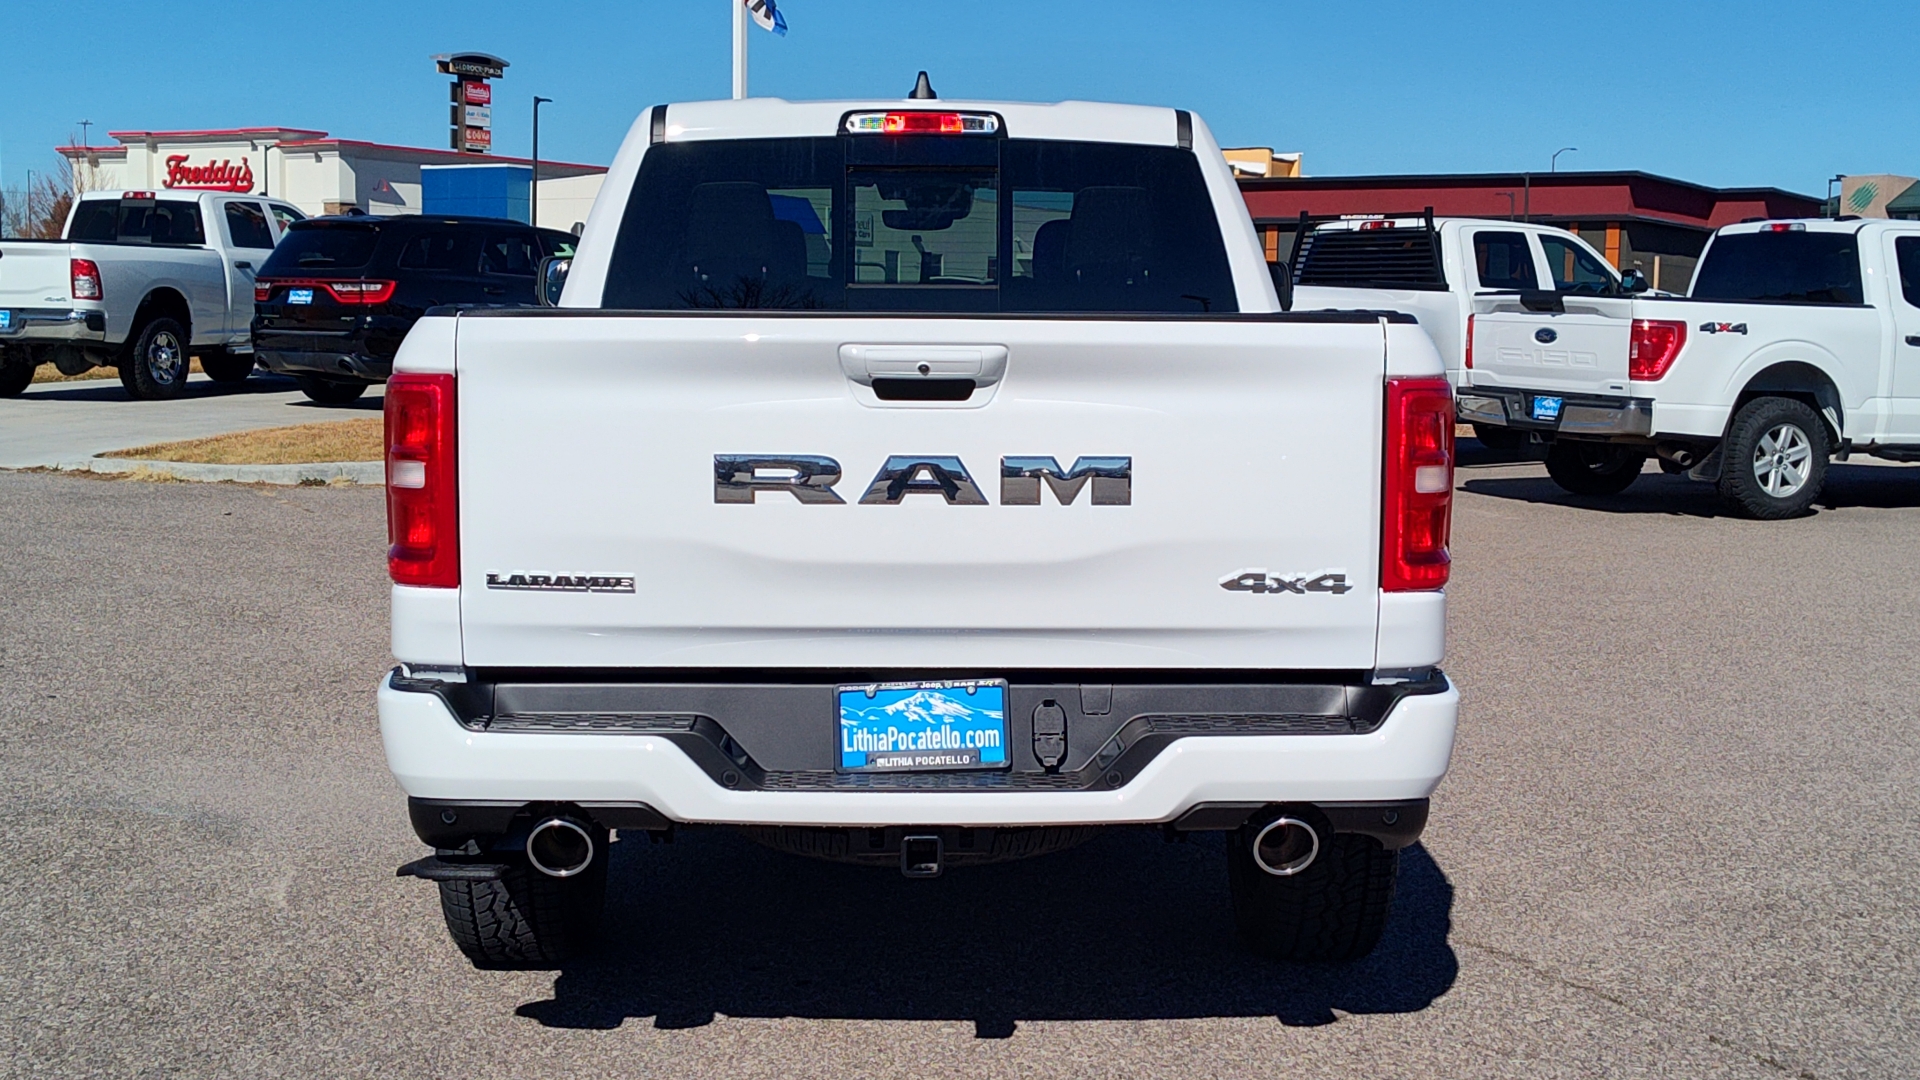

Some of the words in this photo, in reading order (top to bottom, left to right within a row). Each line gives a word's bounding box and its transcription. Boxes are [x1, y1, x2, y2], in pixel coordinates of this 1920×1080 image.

[162, 154, 254, 193] Freddy's
[1496, 347, 1597, 367] F-150
[714, 454, 1132, 506] RAM
[486, 572, 636, 593] LARAMIE
[843, 725, 1000, 752] LithiaPocatello.com
[885, 755, 913, 767] LITHIA
[916, 755, 970, 766] POCATELLO
